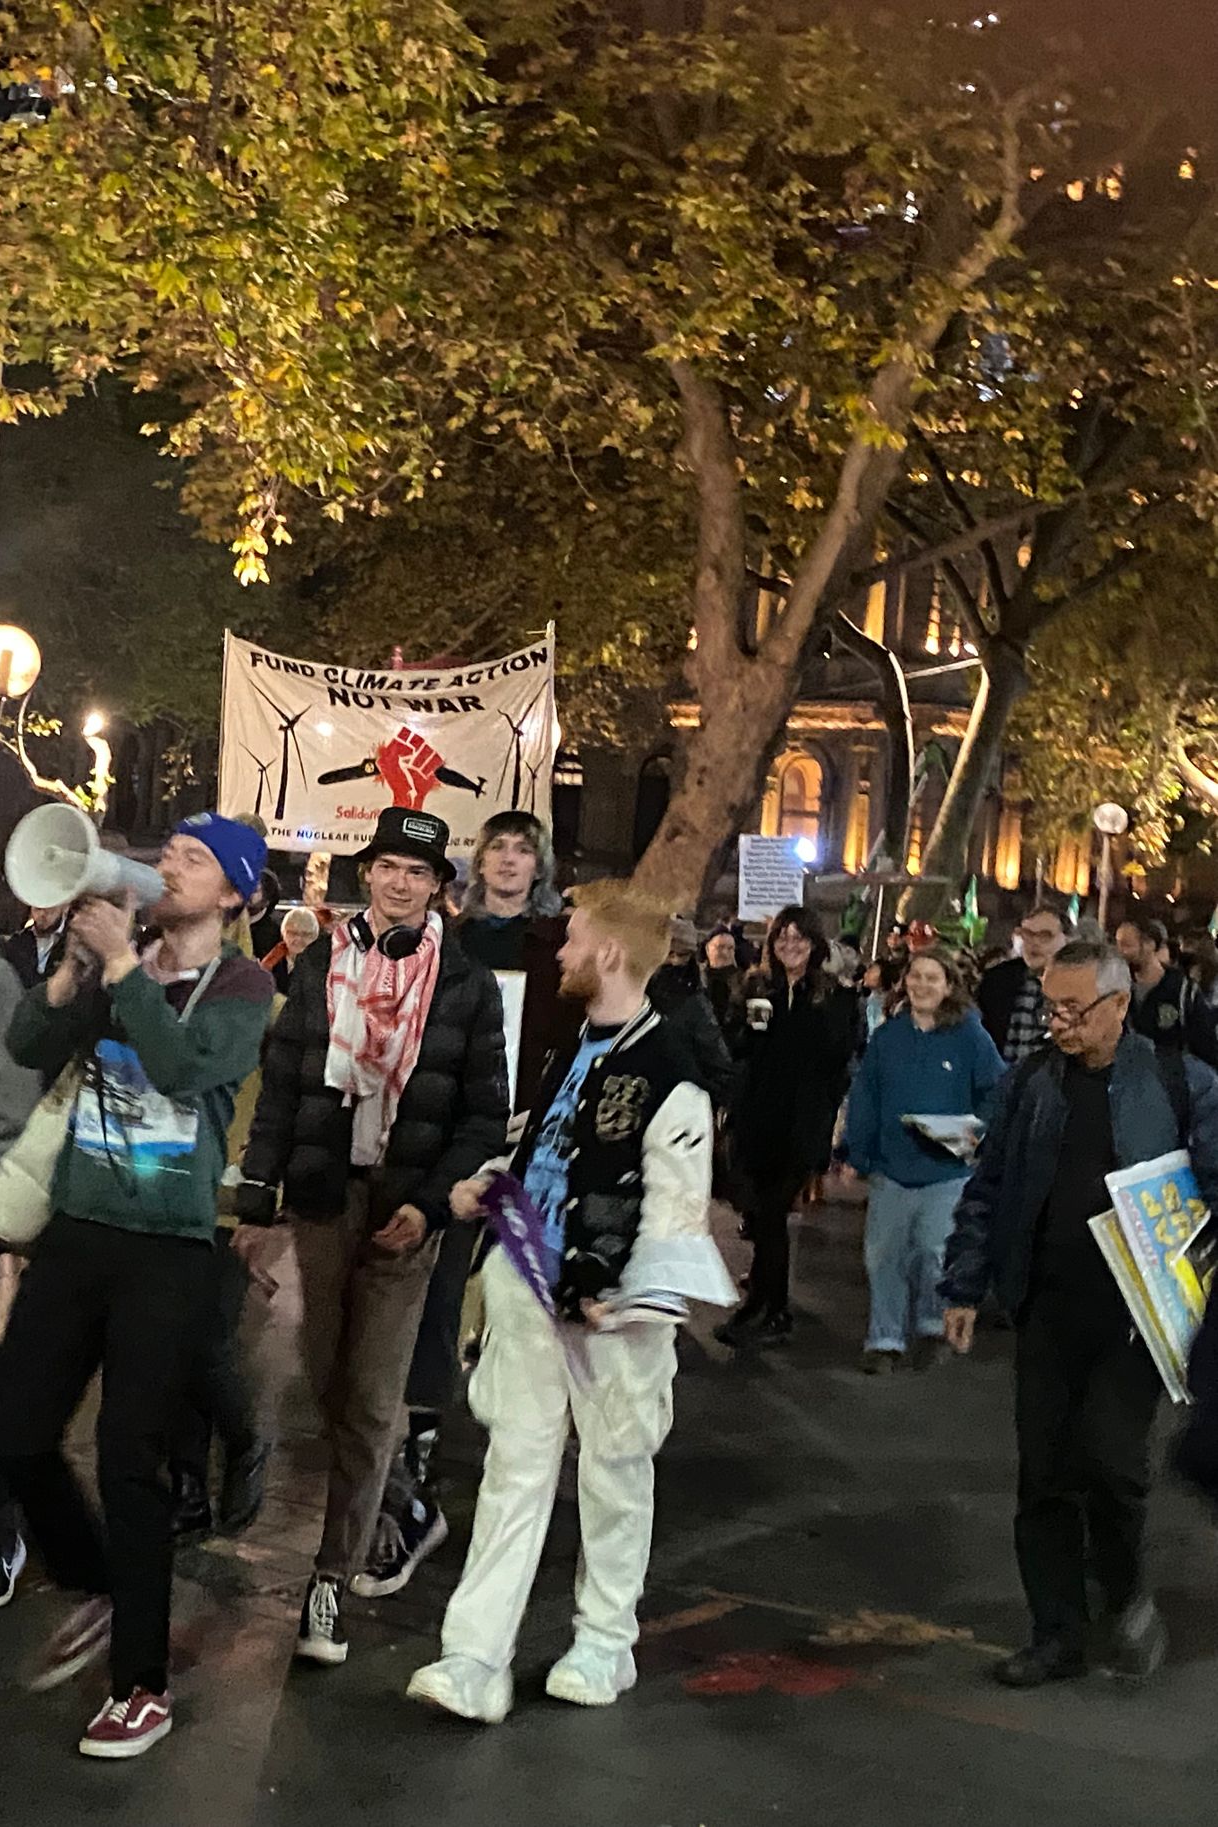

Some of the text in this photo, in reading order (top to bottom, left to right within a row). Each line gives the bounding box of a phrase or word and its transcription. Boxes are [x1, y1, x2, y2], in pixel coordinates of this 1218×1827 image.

[250, 647, 548, 691] FUND CLIMATE ACTION
[327, 686, 486, 713] NOT WAR
[271, 827, 292, 837] THE
[296, 829, 350, 842] NUCLEAR
